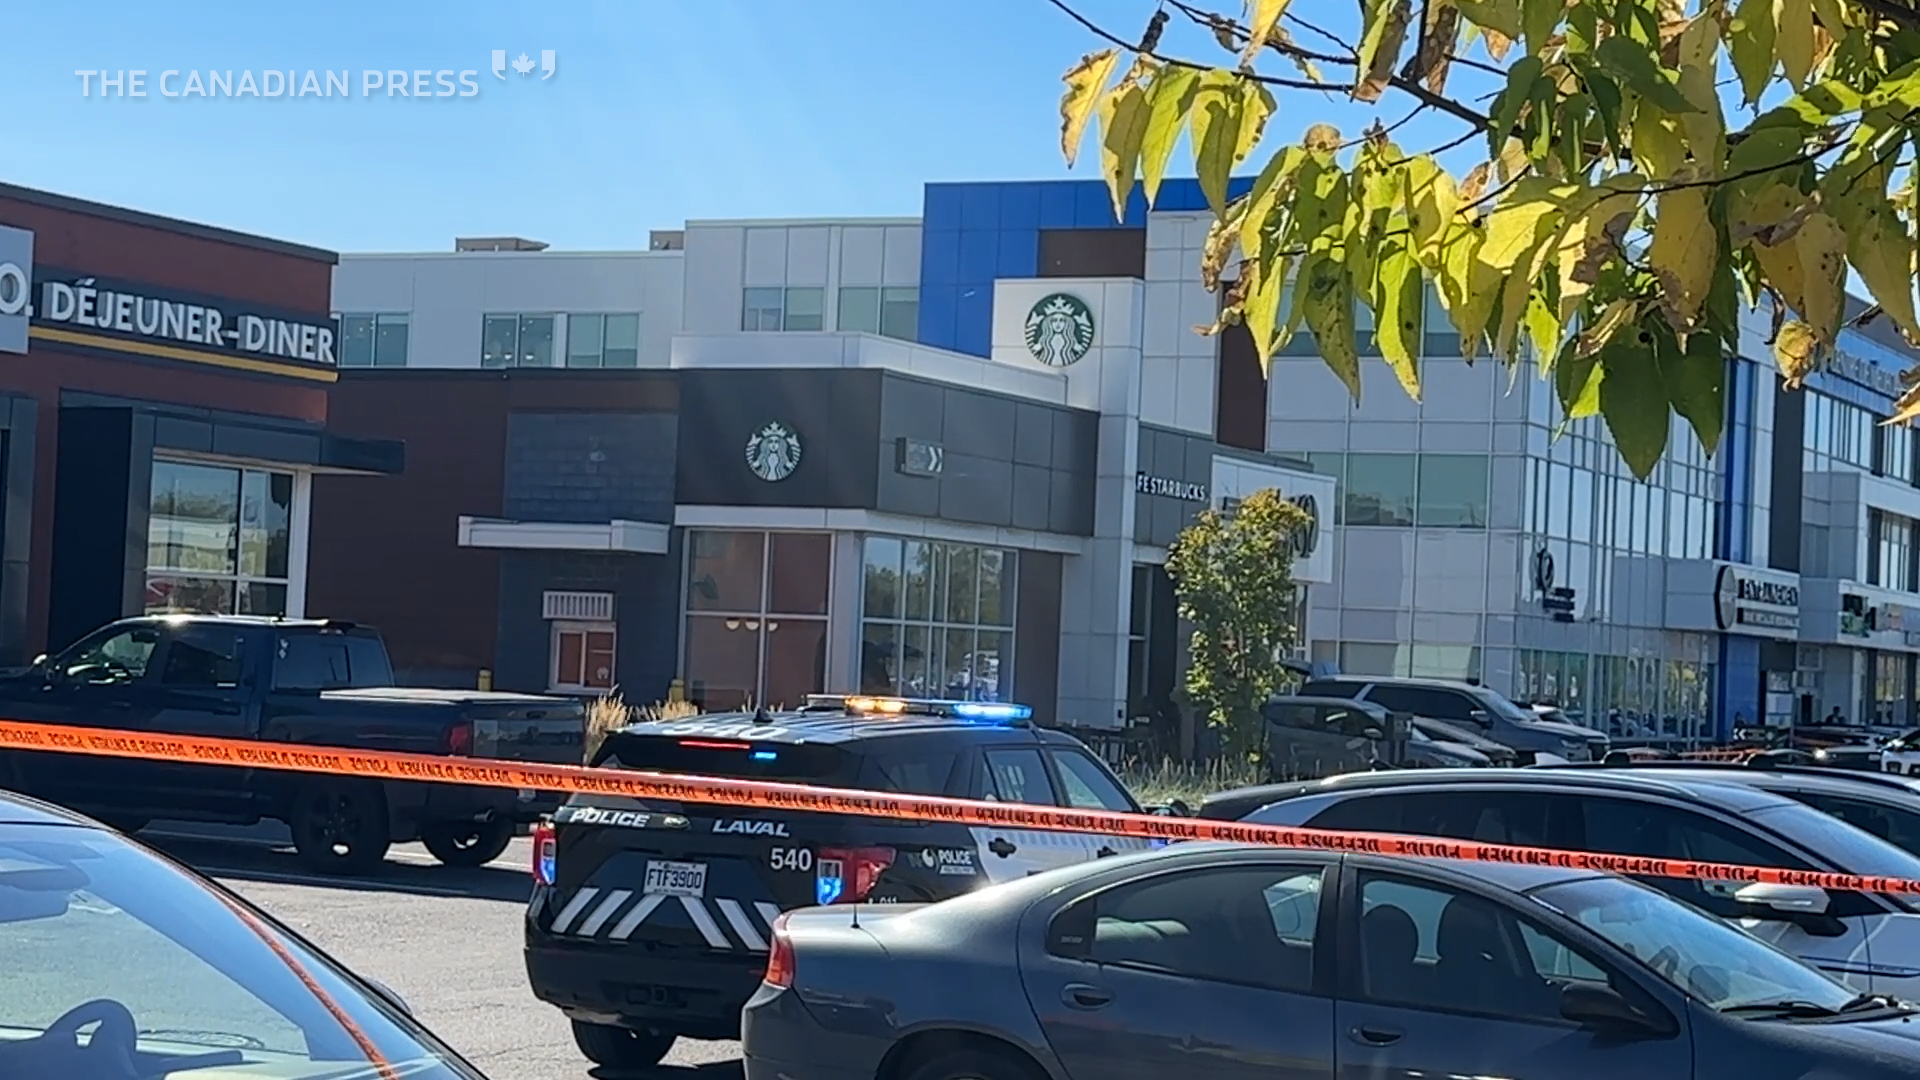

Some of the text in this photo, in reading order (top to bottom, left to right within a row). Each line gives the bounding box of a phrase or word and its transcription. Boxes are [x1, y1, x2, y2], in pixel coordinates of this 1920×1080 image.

[50, 278, 336, 363] DÉJEUNER-DINER
[1150, 477, 1205, 502] STARBUCKS
[569, 811, 650, 828] POLICE
[712, 819, 790, 837] LAVAL
[770, 848, 812, 871] 540
[938, 849, 972, 865] POLICE
[647, 869, 702, 889] FTF3900
